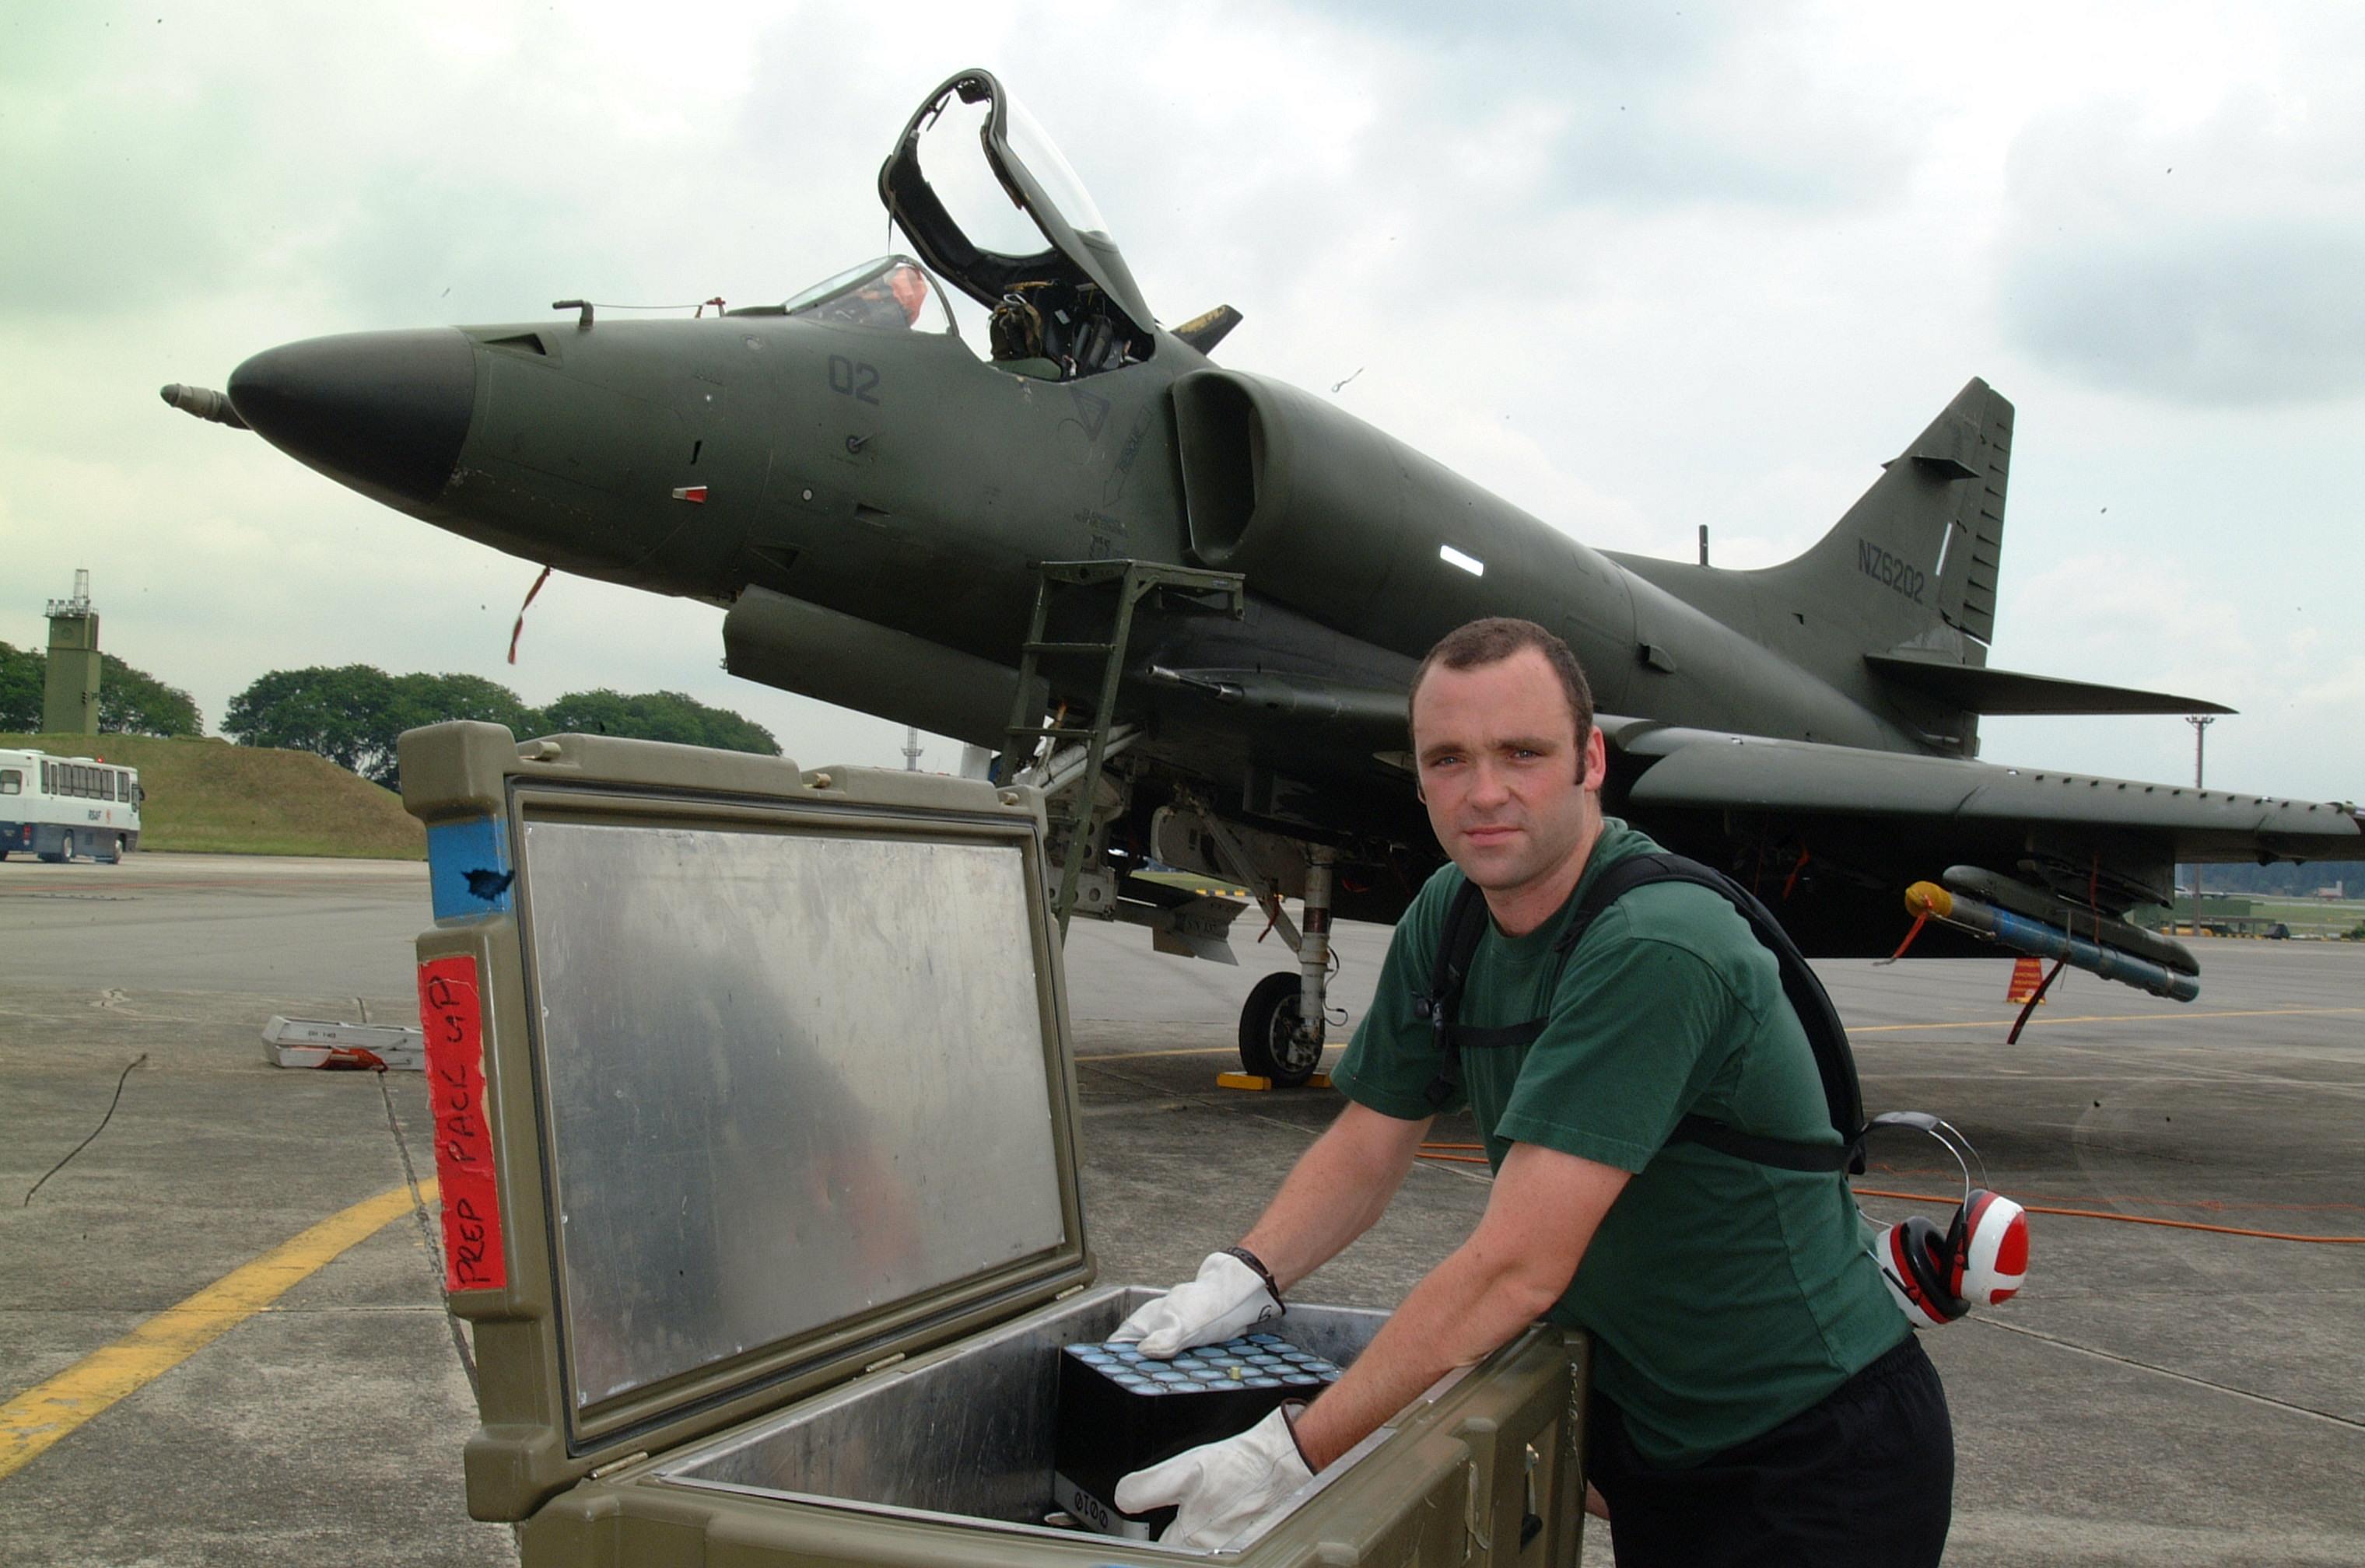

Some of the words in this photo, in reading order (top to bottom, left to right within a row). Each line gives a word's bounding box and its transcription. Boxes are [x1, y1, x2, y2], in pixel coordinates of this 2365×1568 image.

[829, 354, 880, 406] 02
[1858, 538, 1925, 604] NZ6202
[440, 1064, 476, 1162] PACK
[456, 1198, 491, 1284] PREP
